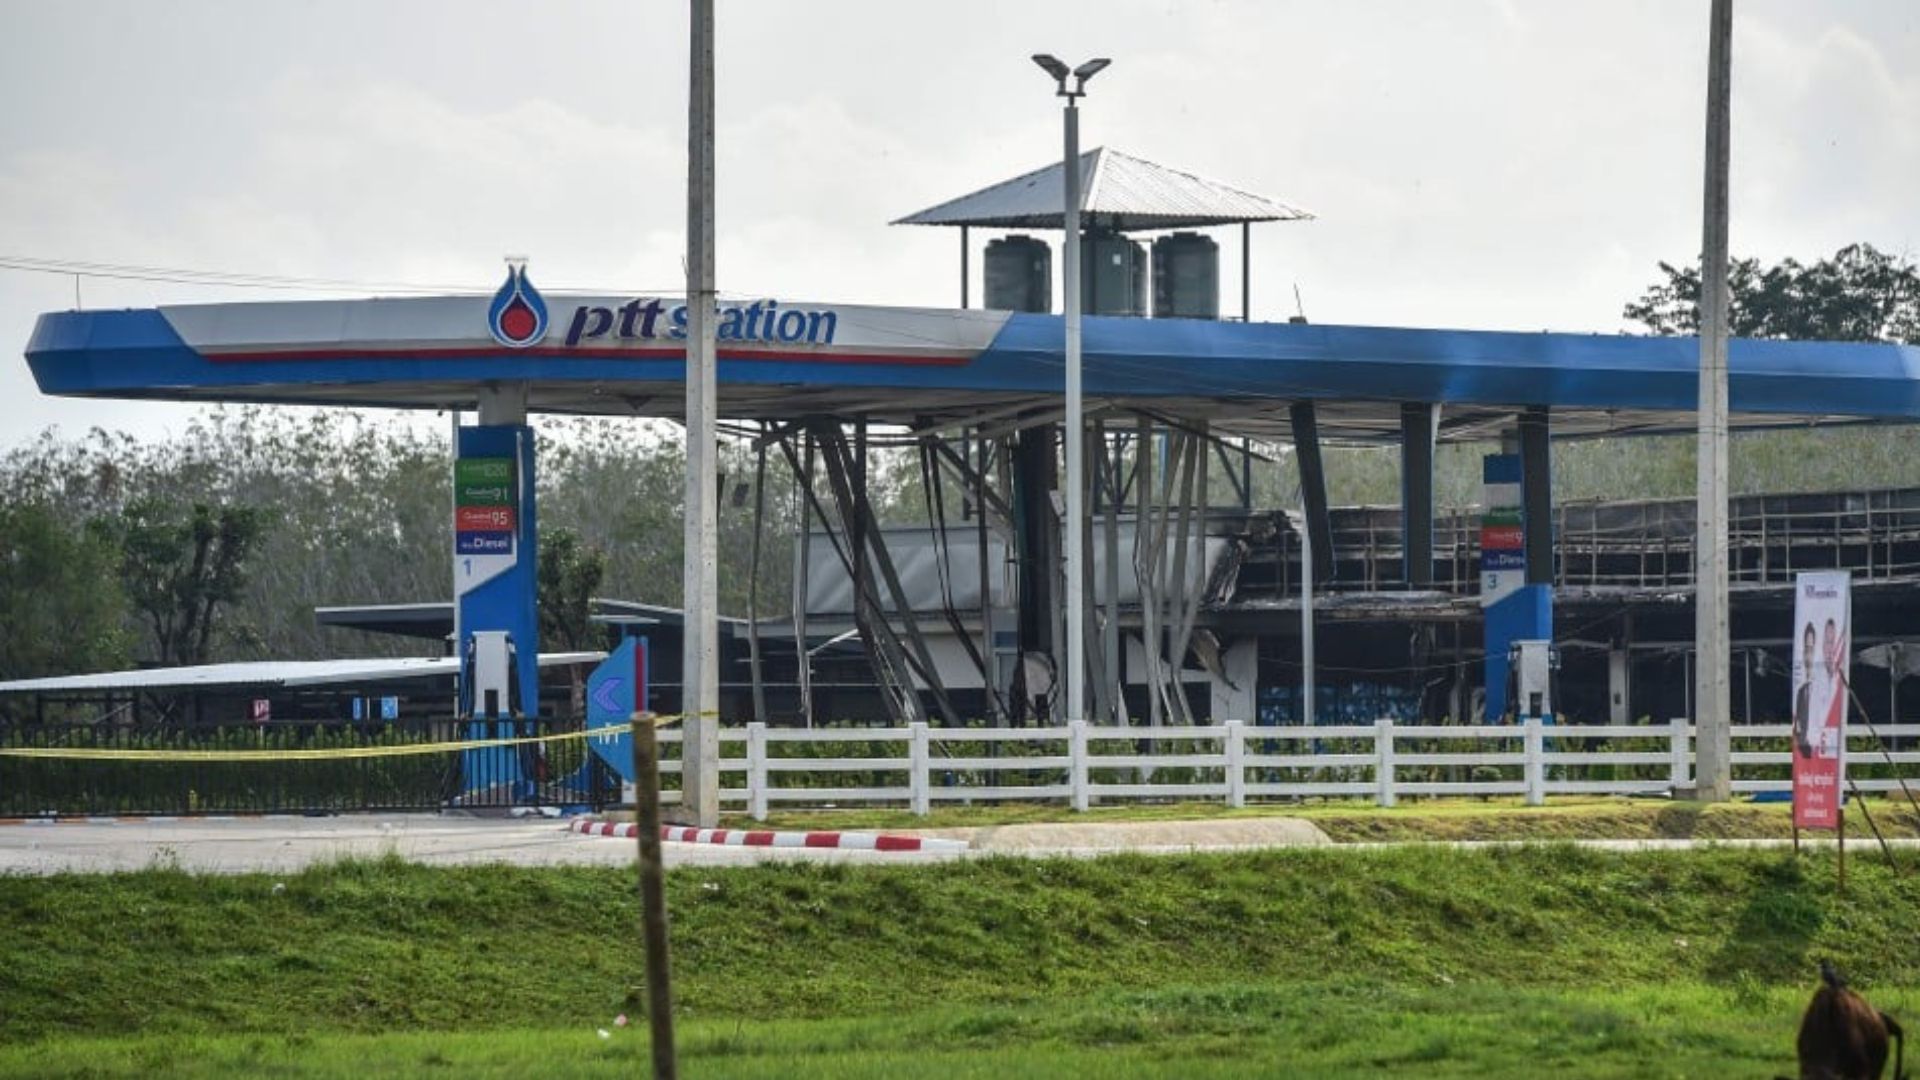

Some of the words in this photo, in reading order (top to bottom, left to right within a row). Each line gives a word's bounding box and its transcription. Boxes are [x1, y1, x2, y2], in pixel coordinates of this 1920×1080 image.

[565, 298, 666, 345] ptt
[669, 298, 837, 344] sation
[491, 511, 508, 526] 95
[463, 558, 472, 577] 1
[1487, 574, 1497, 589] 3
